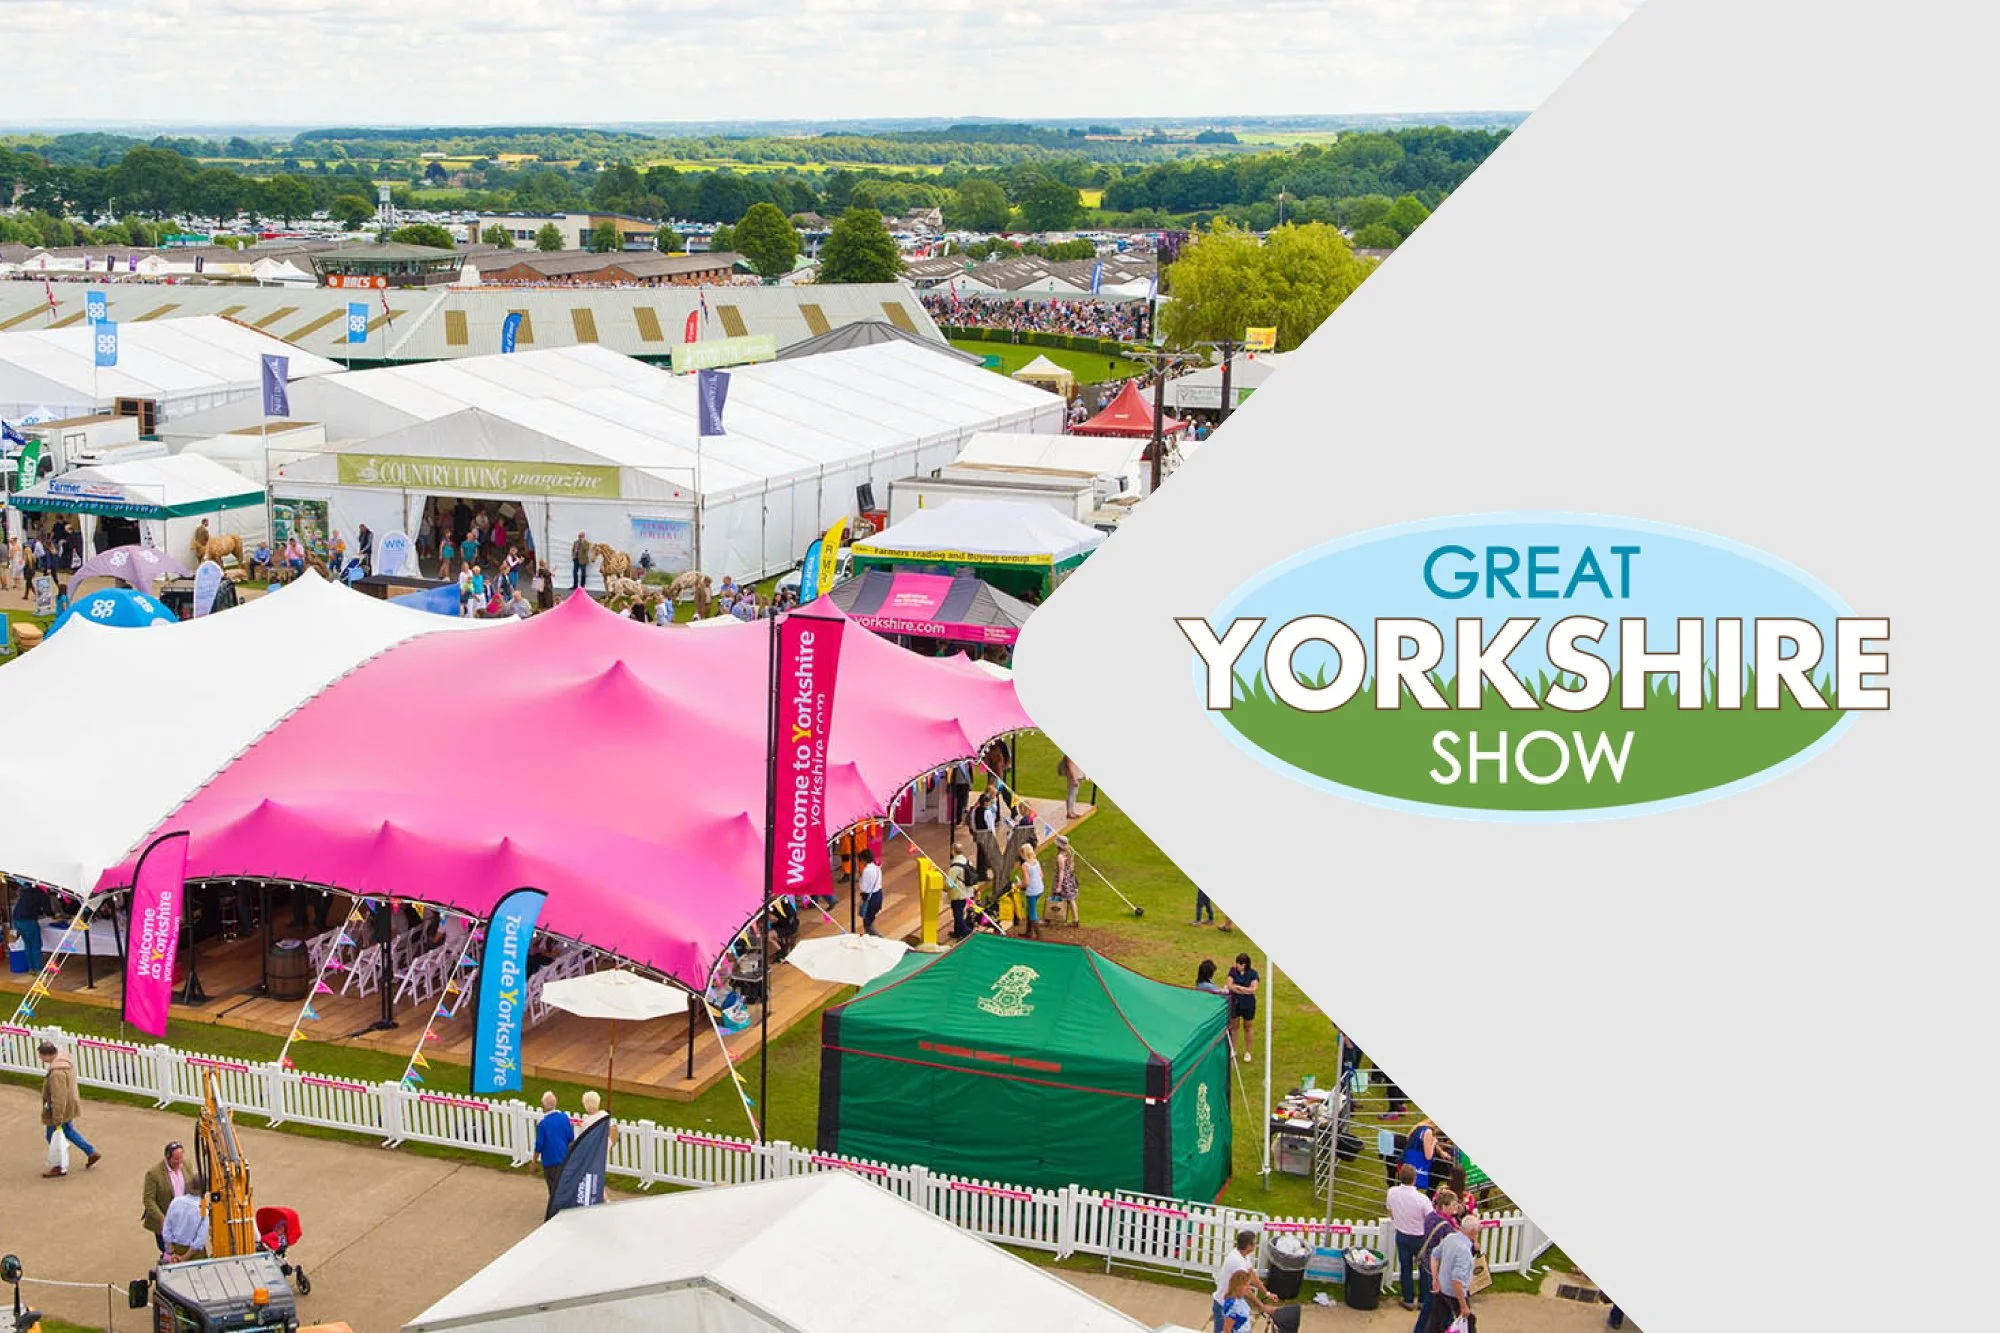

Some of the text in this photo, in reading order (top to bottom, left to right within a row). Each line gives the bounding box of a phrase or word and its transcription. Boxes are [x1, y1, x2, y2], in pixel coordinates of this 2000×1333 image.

[380, 462, 601, 491] COUNTRY LIVING magazine
[874, 547, 909, 557] Farmers
[947, 552, 966, 560] and
[967, 552, 999, 563] Buying
[853, 616, 945, 635] yorkshire.com
[786, 630, 815, 886] Welcome to Yorkshire
[138, 907, 156, 977] Welcome
[151, 890, 172, 961] Yorkshire
[489, 915, 522, 1087] Tour de Yorkshire
